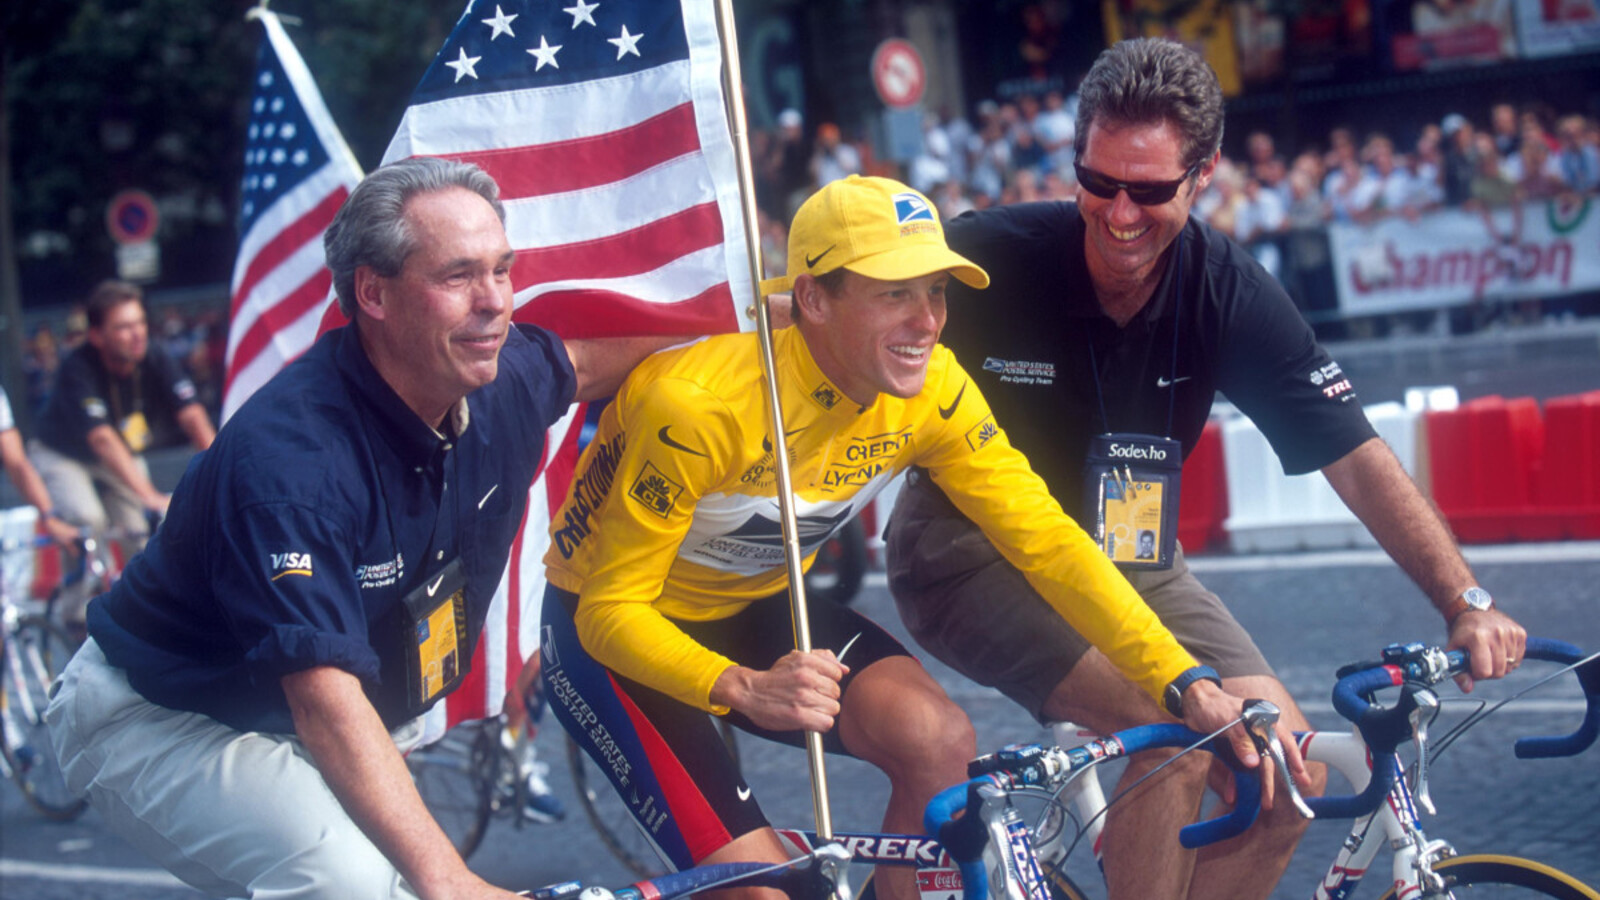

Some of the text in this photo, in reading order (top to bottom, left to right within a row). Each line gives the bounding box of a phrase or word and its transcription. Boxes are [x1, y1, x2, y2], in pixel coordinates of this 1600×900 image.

[1108, 443, 1167, 460] Sodexho
[642, 490, 660, 510] CL
[270, 552, 312, 570] VISA
[547, 674, 631, 788] POSTAL SERVICE
[555, 669, 633, 776] UNITED STATES
